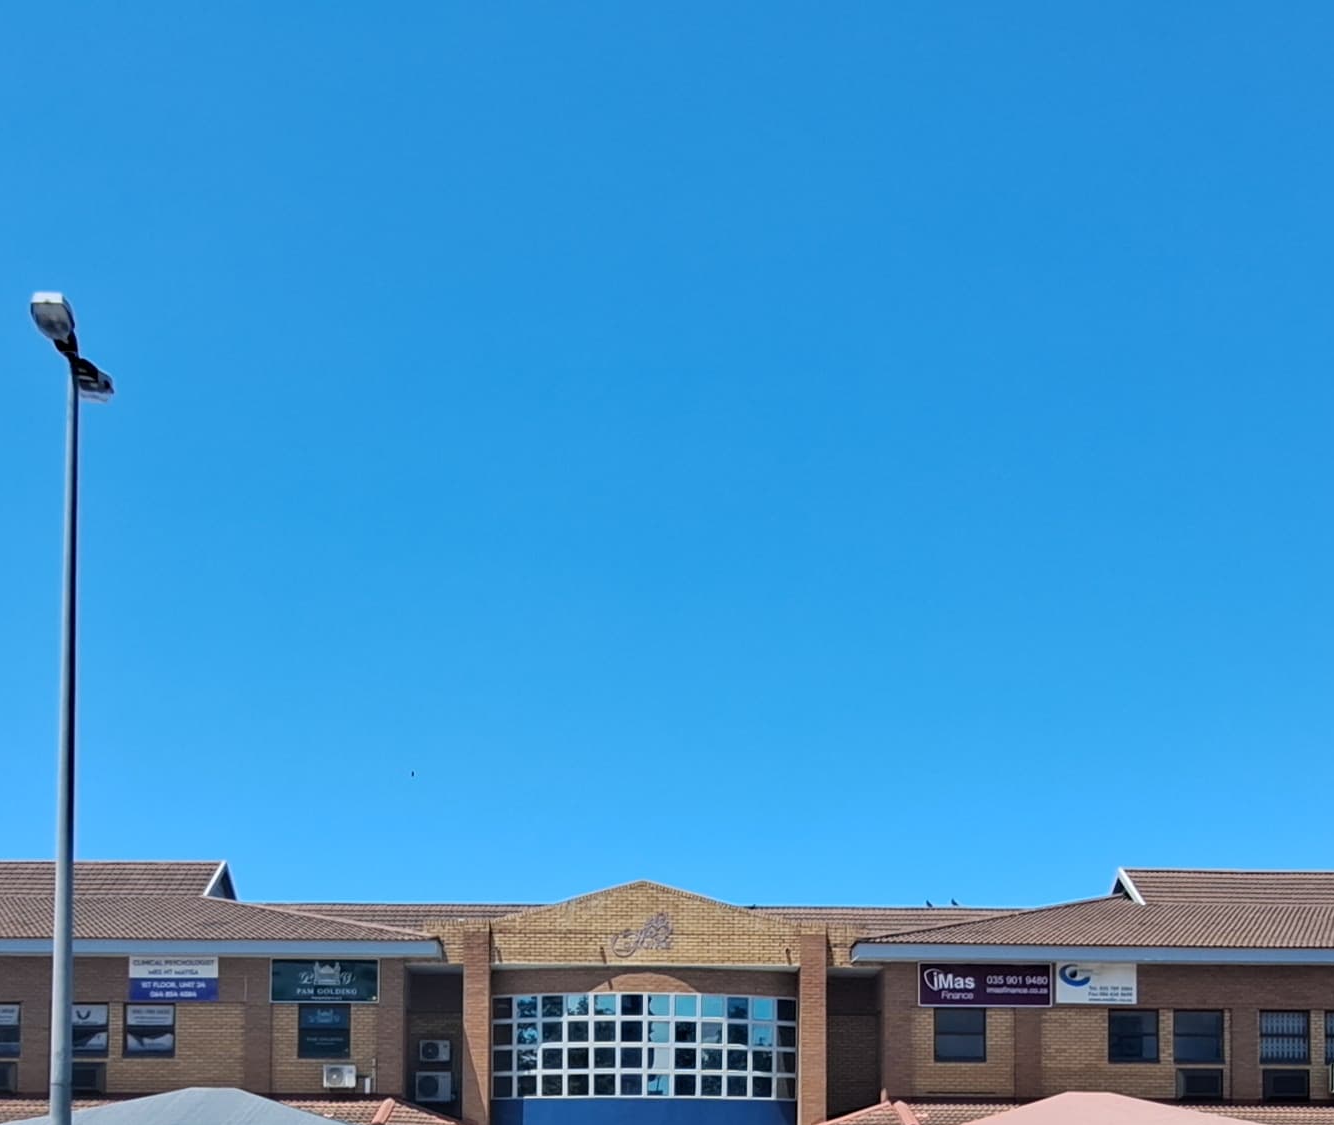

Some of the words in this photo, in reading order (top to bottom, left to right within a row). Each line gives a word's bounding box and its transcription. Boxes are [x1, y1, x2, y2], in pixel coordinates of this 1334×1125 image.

[932, 971, 975, 989] iMas
[986, 975, 1004, 985] 035
[1006, 975, 1022, 985] 901
[1025, 975, 1048, 985] 9480
[941, 991, 974, 1000] Finance
